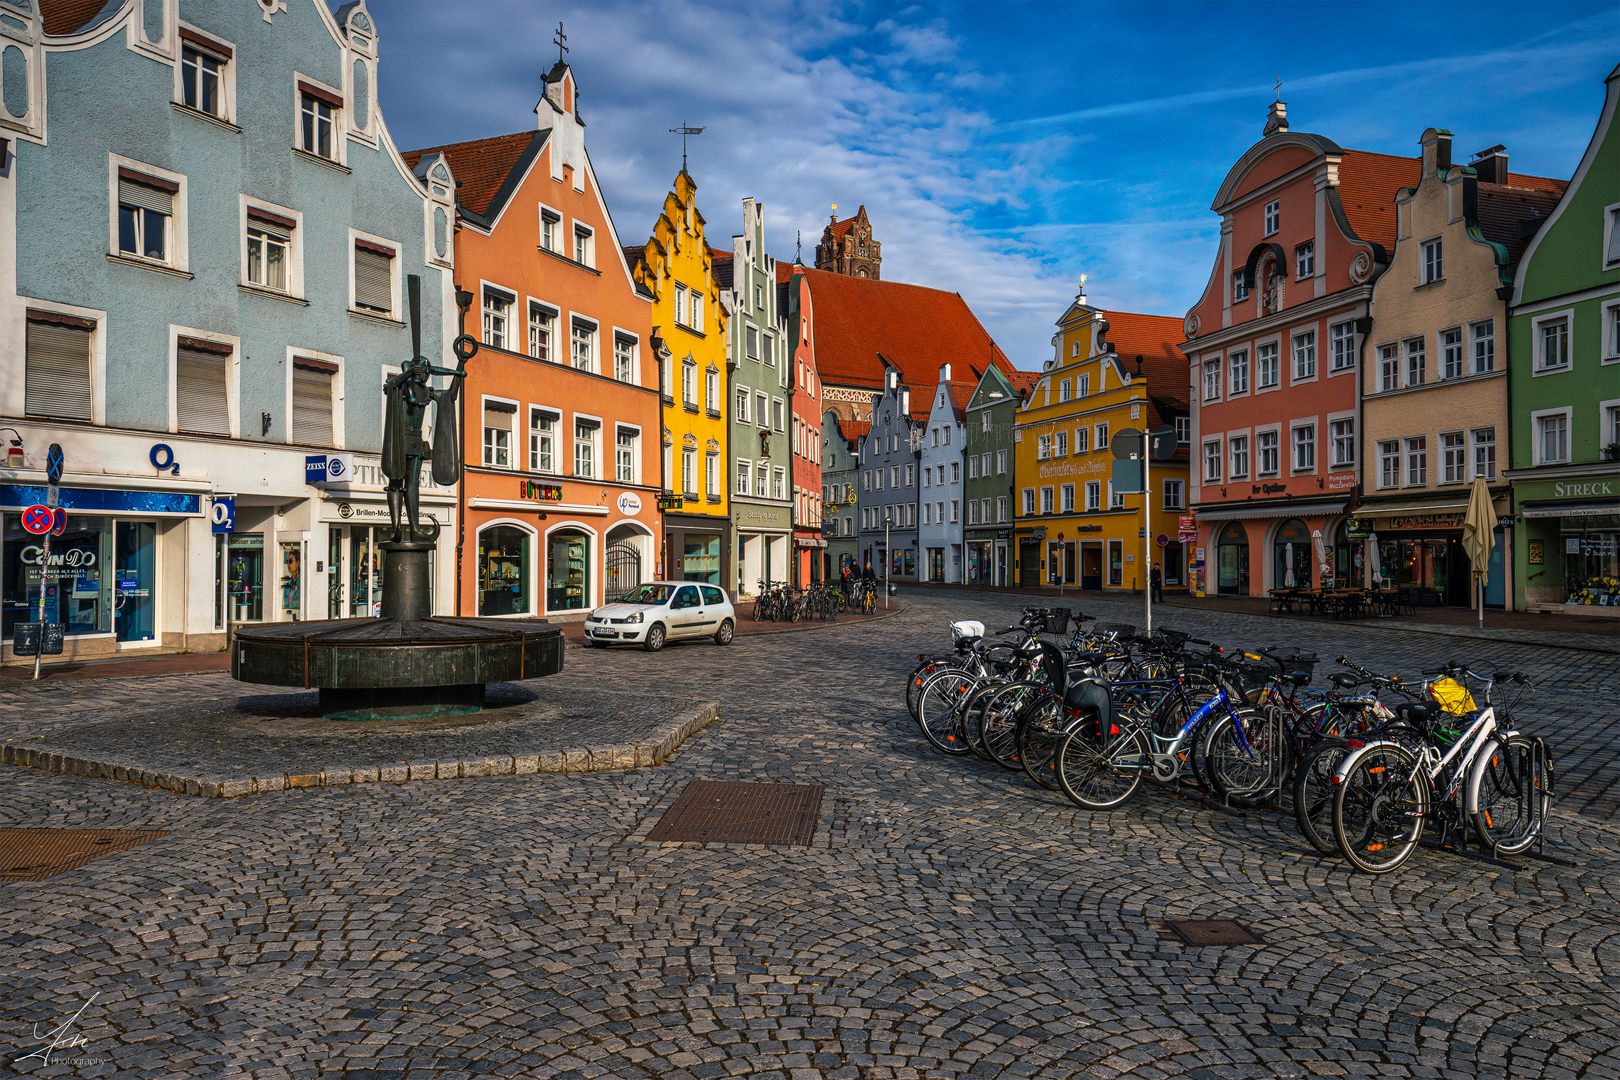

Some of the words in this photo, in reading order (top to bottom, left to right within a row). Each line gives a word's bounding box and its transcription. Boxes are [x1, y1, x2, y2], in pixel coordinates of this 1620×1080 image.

[306, 462, 326, 471] ZEISS
[353, 464, 388, 485] PTIK
[1329, 474, 1355, 482] Pomodoro
[521, 481, 562, 500] BUTLERS
[1252, 484, 1261, 494] Ihr
[1262, 483, 1286, 495] Optiker
[356, 508, 391, 517] Brillen-Mod
